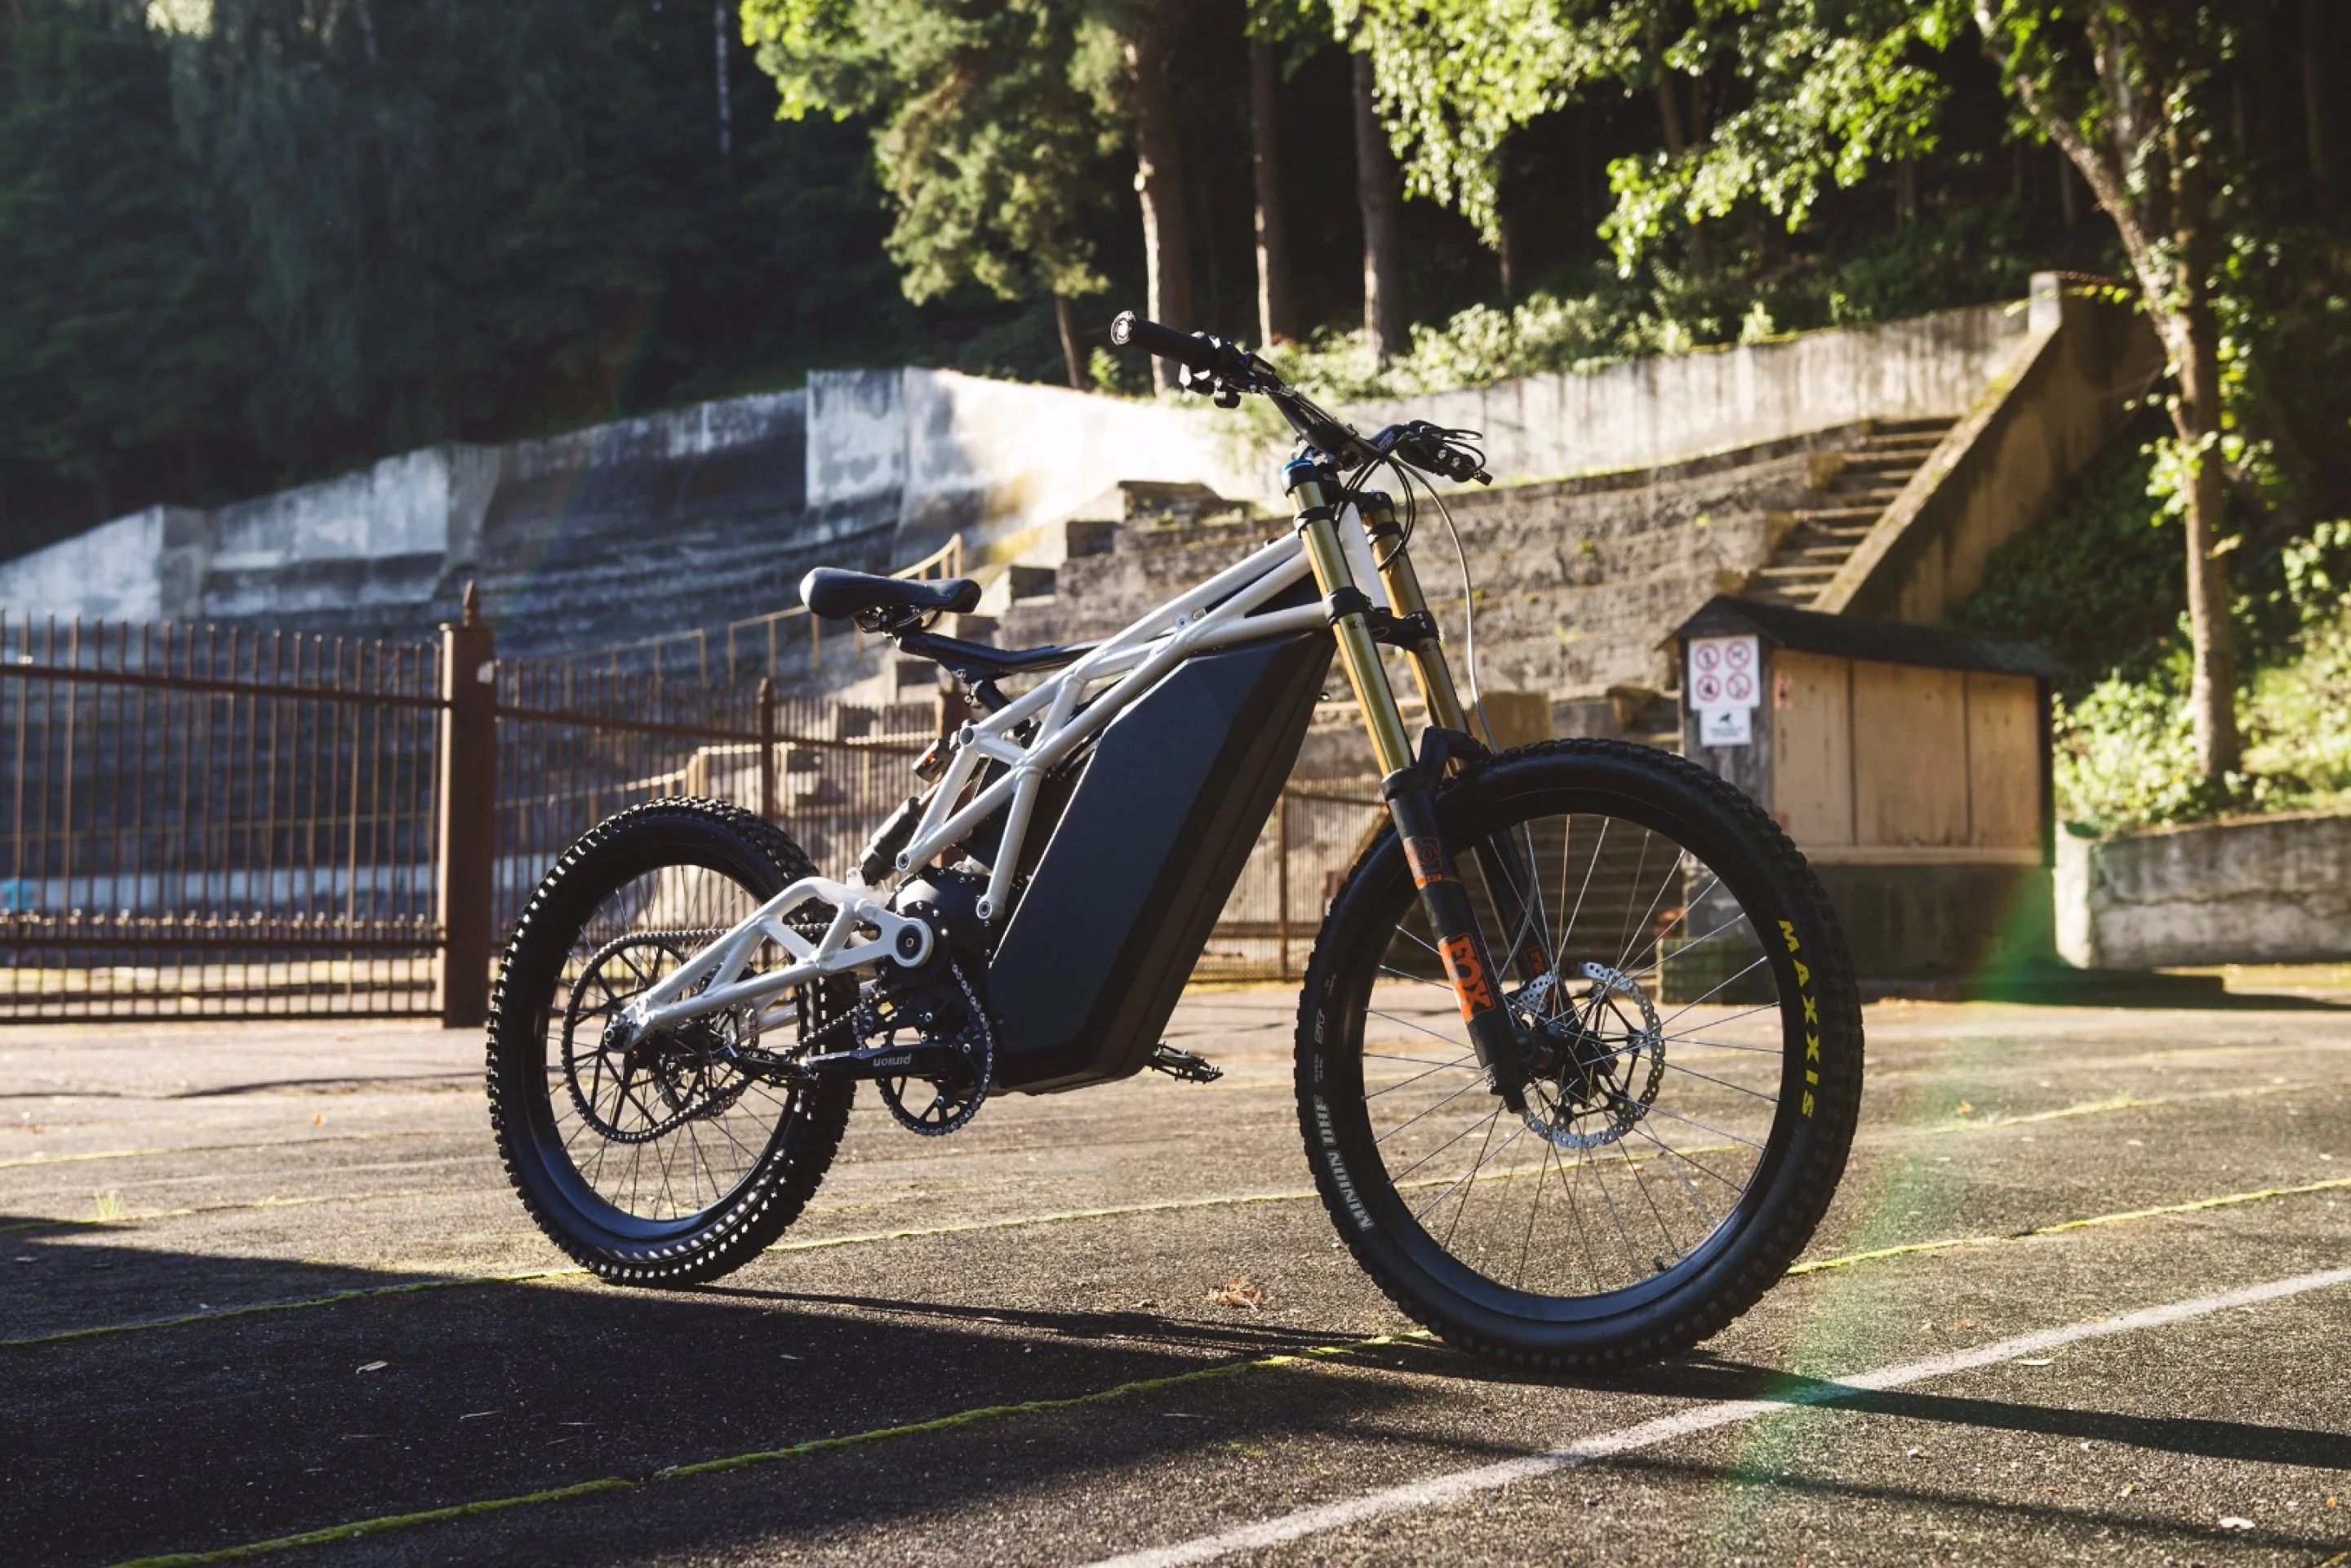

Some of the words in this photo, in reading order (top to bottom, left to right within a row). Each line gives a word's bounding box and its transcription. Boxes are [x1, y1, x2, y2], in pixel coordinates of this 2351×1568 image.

[1438, 935, 1492, 1022] FOX
[1778, 920, 1820, 1118] MAXXIS
[873, 1053, 912, 1067] pinion
[1326, 1151, 1375, 1231] MINION
